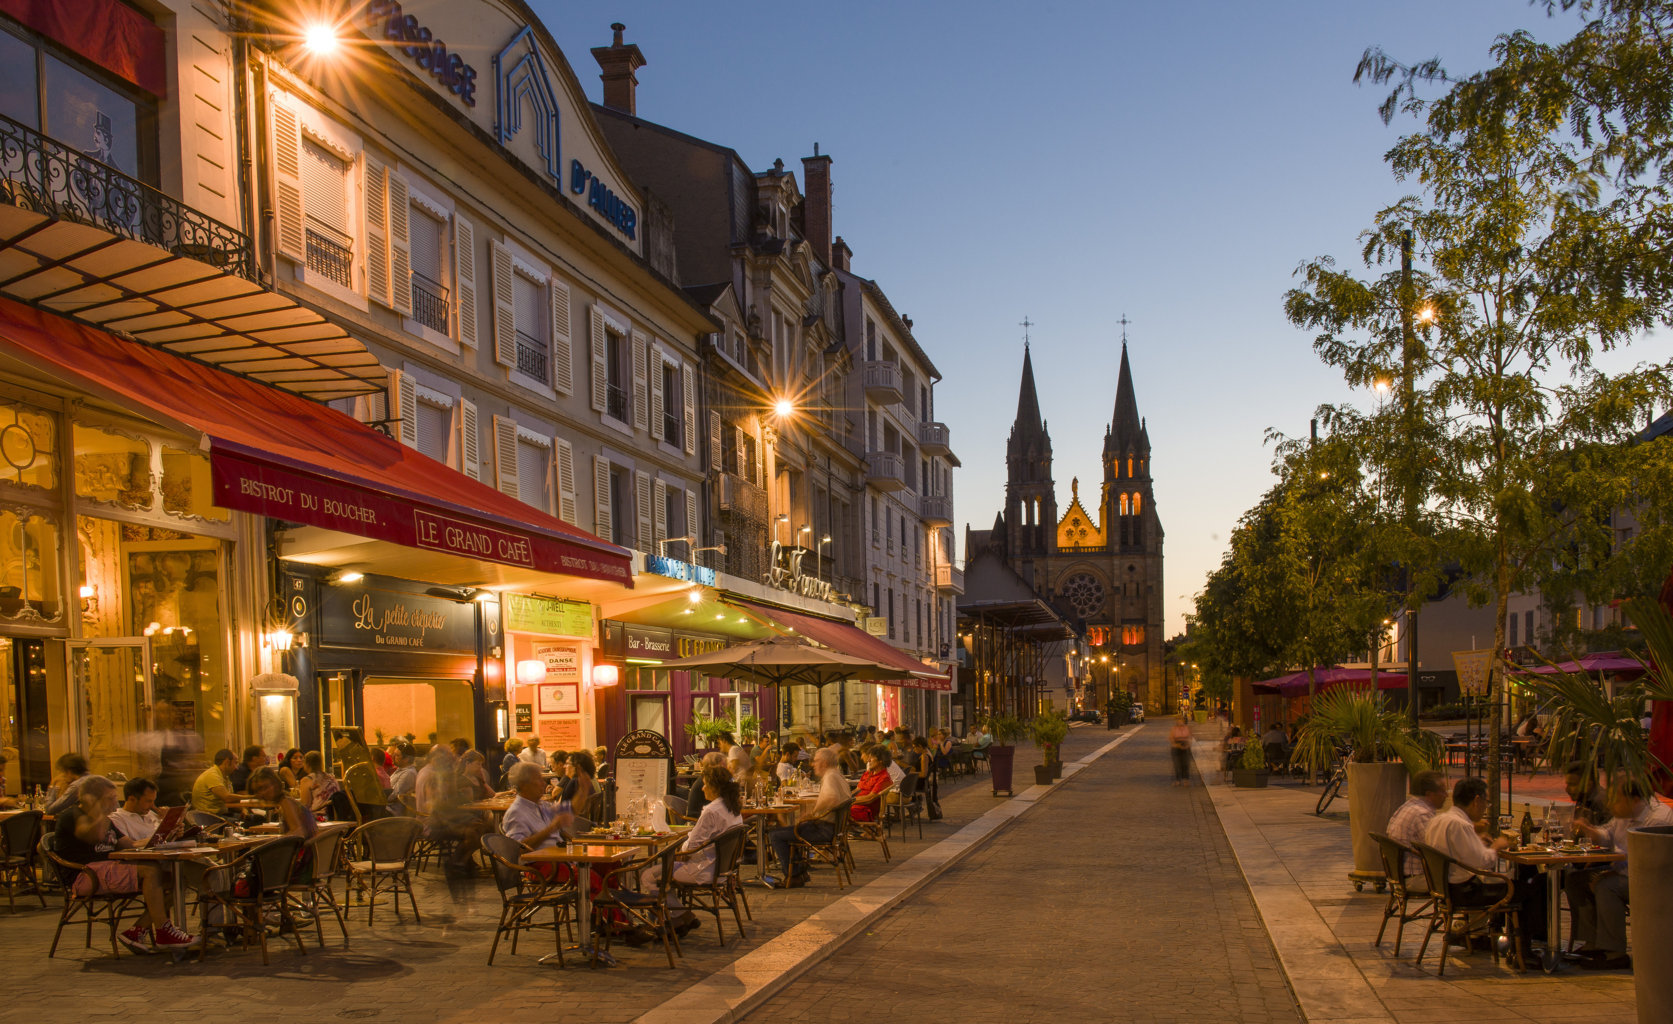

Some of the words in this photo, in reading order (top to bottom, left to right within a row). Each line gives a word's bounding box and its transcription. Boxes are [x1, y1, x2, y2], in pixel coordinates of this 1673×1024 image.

[571, 159, 636, 240] D'ALLIER
[240, 477, 294, 505] BISTROT
[301, 492, 318, 511] DU
[323, 499, 377, 524] BOUCHER
[420, 520, 439, 543] LE
[445, 527, 492, 554] GRAND
[498, 539, 530, 562] CAFÉ
[560, 555, 588, 571] BISTROT
[352, 593, 384, 631] La
[384, 602, 409, 633] petite
[375, 635, 385, 645] Du
[386, 636, 408, 646] GRAND
[409, 636, 424, 647] CAFÉ
[628, 635, 640, 649] Bar
[645, 637, 670, 652] Brasserie
[678, 638, 691, 658] LE
[620, 741, 629, 752] LE
[627, 732, 652, 744] GRAND
